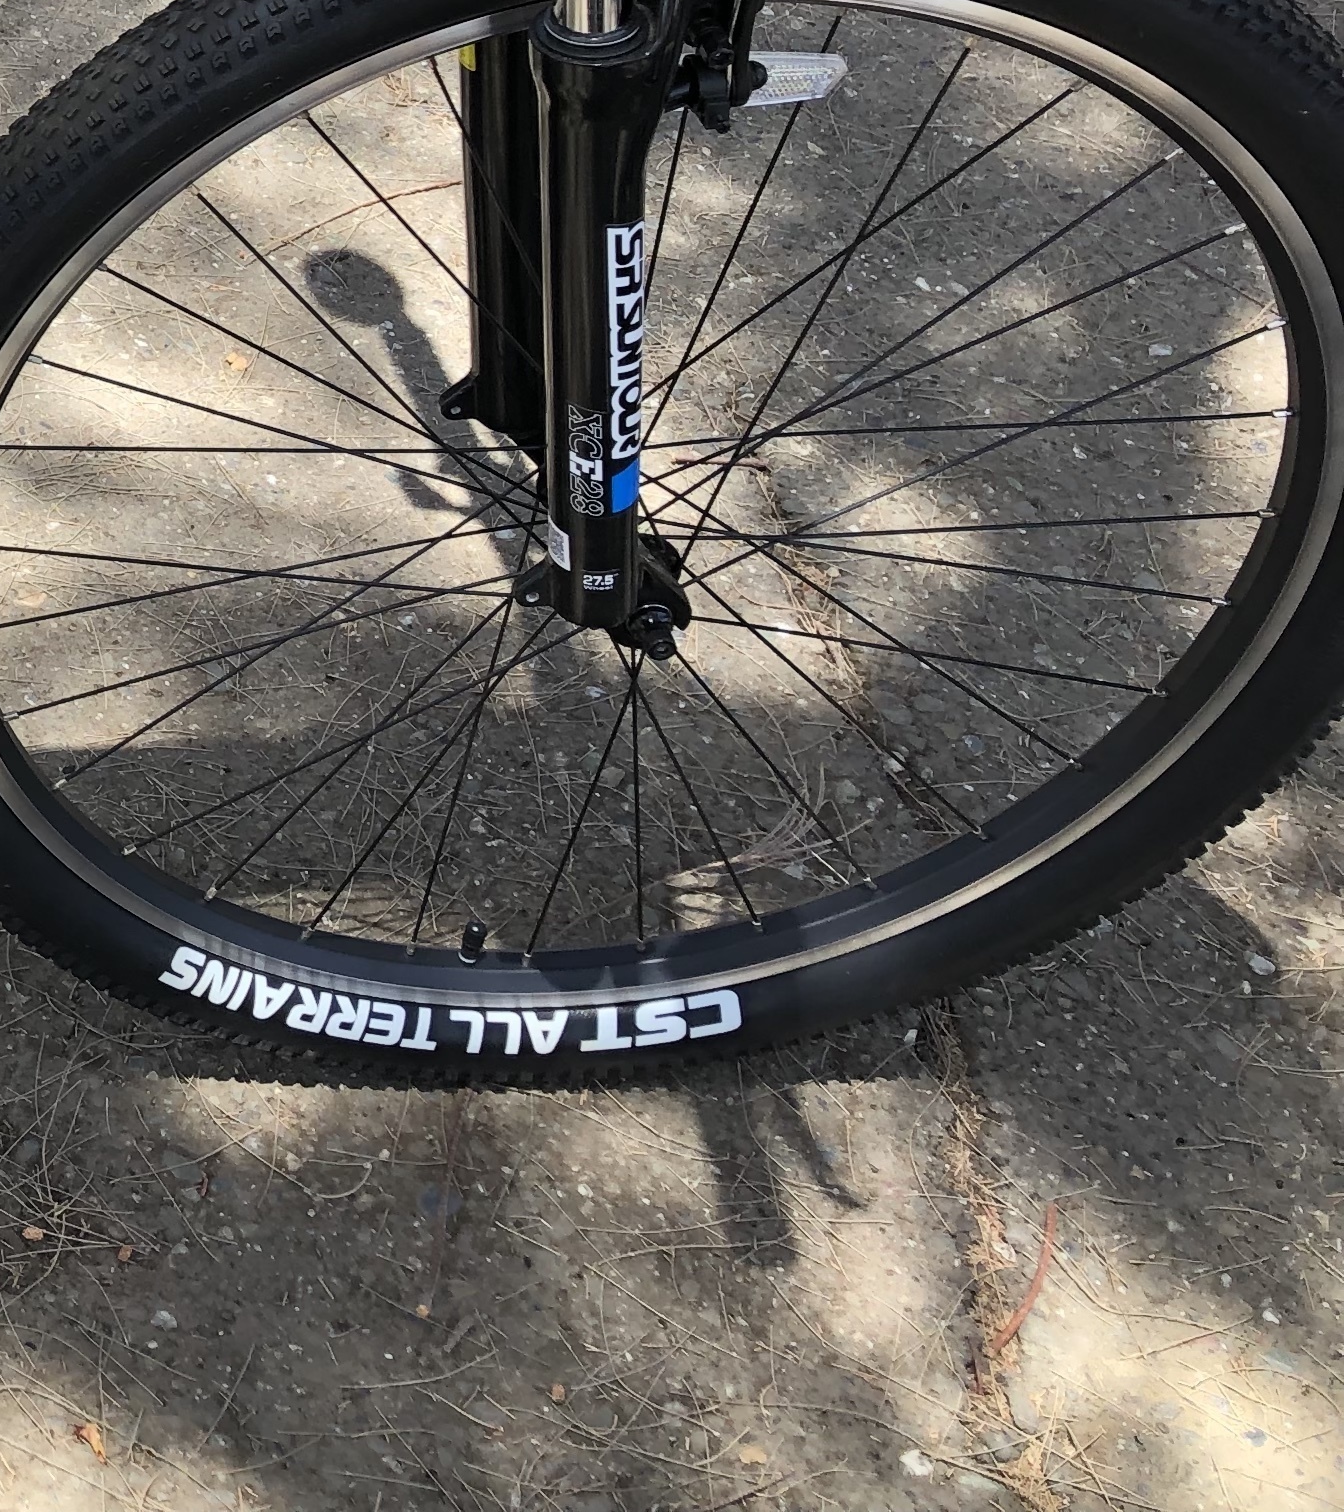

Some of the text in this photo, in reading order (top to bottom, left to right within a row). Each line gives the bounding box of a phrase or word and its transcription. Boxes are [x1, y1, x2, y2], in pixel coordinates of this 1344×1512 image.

[613, 297, 643, 454] SUNTOUR
[567, 404, 604, 516] XCE28
[158, 945, 743, 1056] CST ALL TERRAINS
